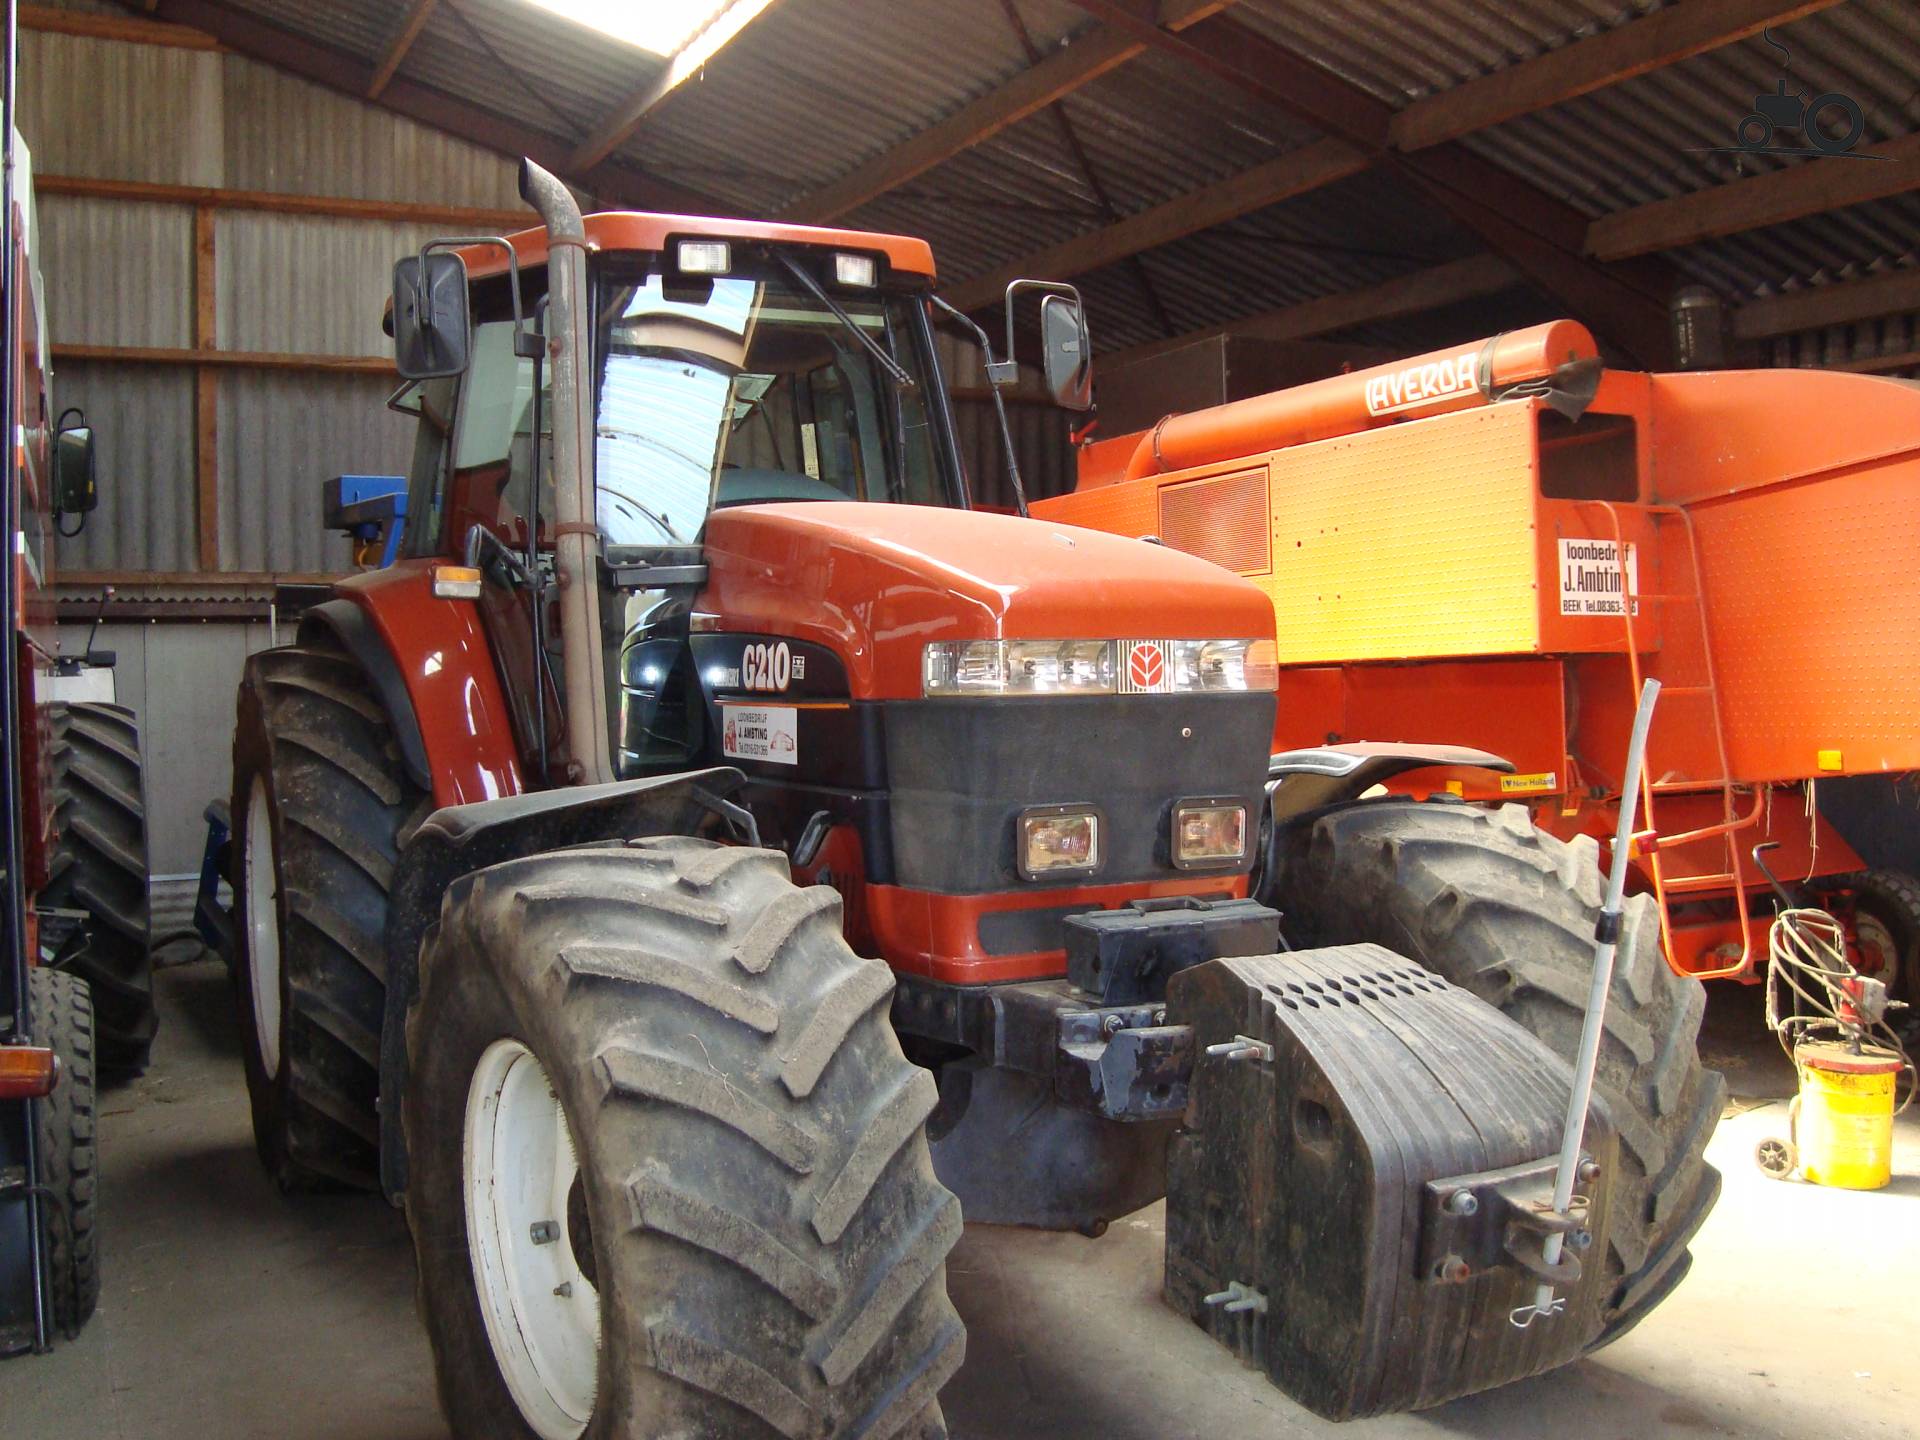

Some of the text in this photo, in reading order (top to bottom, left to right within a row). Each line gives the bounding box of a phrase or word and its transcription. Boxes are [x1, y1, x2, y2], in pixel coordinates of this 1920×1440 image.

[1566, 541, 1630, 561] loonbedrf
[1563, 599, 1582, 612] BEEK
[742, 641, 791, 692] G210
[744, 726, 769, 741] AMBTING
